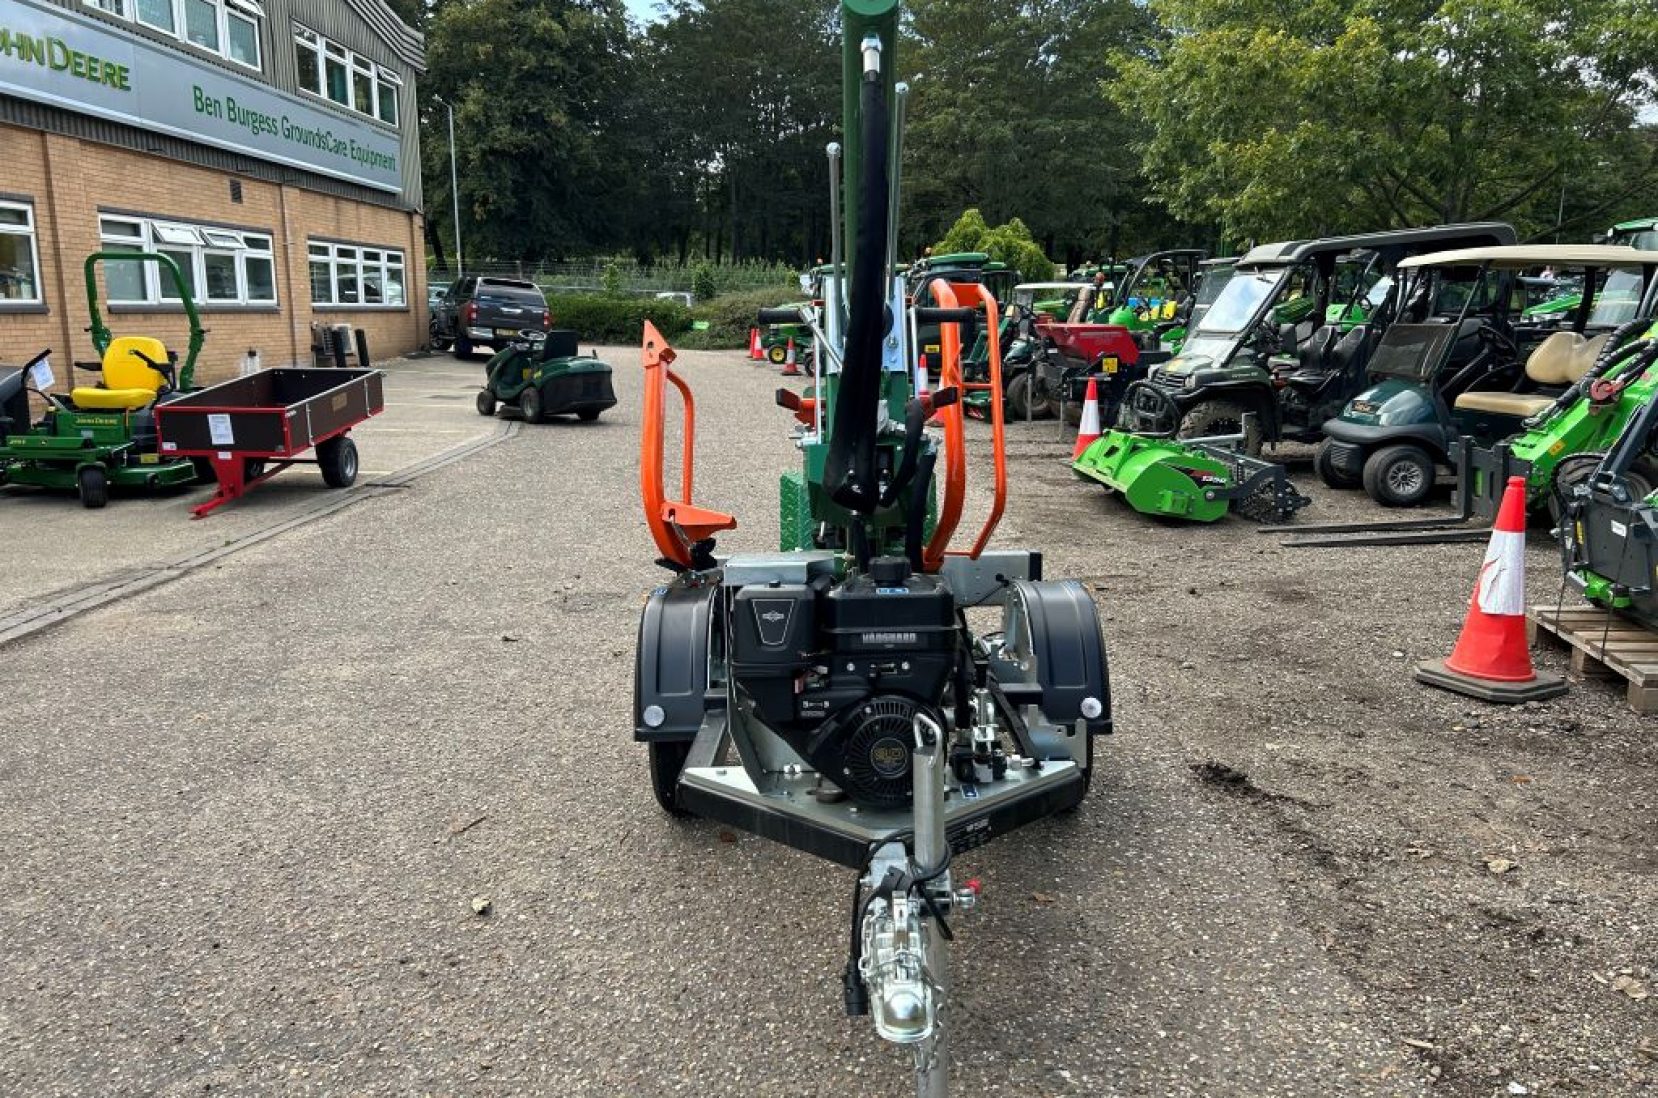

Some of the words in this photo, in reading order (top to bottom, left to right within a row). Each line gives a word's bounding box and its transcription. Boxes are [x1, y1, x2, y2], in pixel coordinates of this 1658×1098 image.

[46, 35, 132, 92] DEERE
[193, 85, 222, 119] Ben
[226, 96, 278, 136] Burgess
[281, 115, 348, 158] GroundsCare
[350, 138, 396, 172] Equipment
